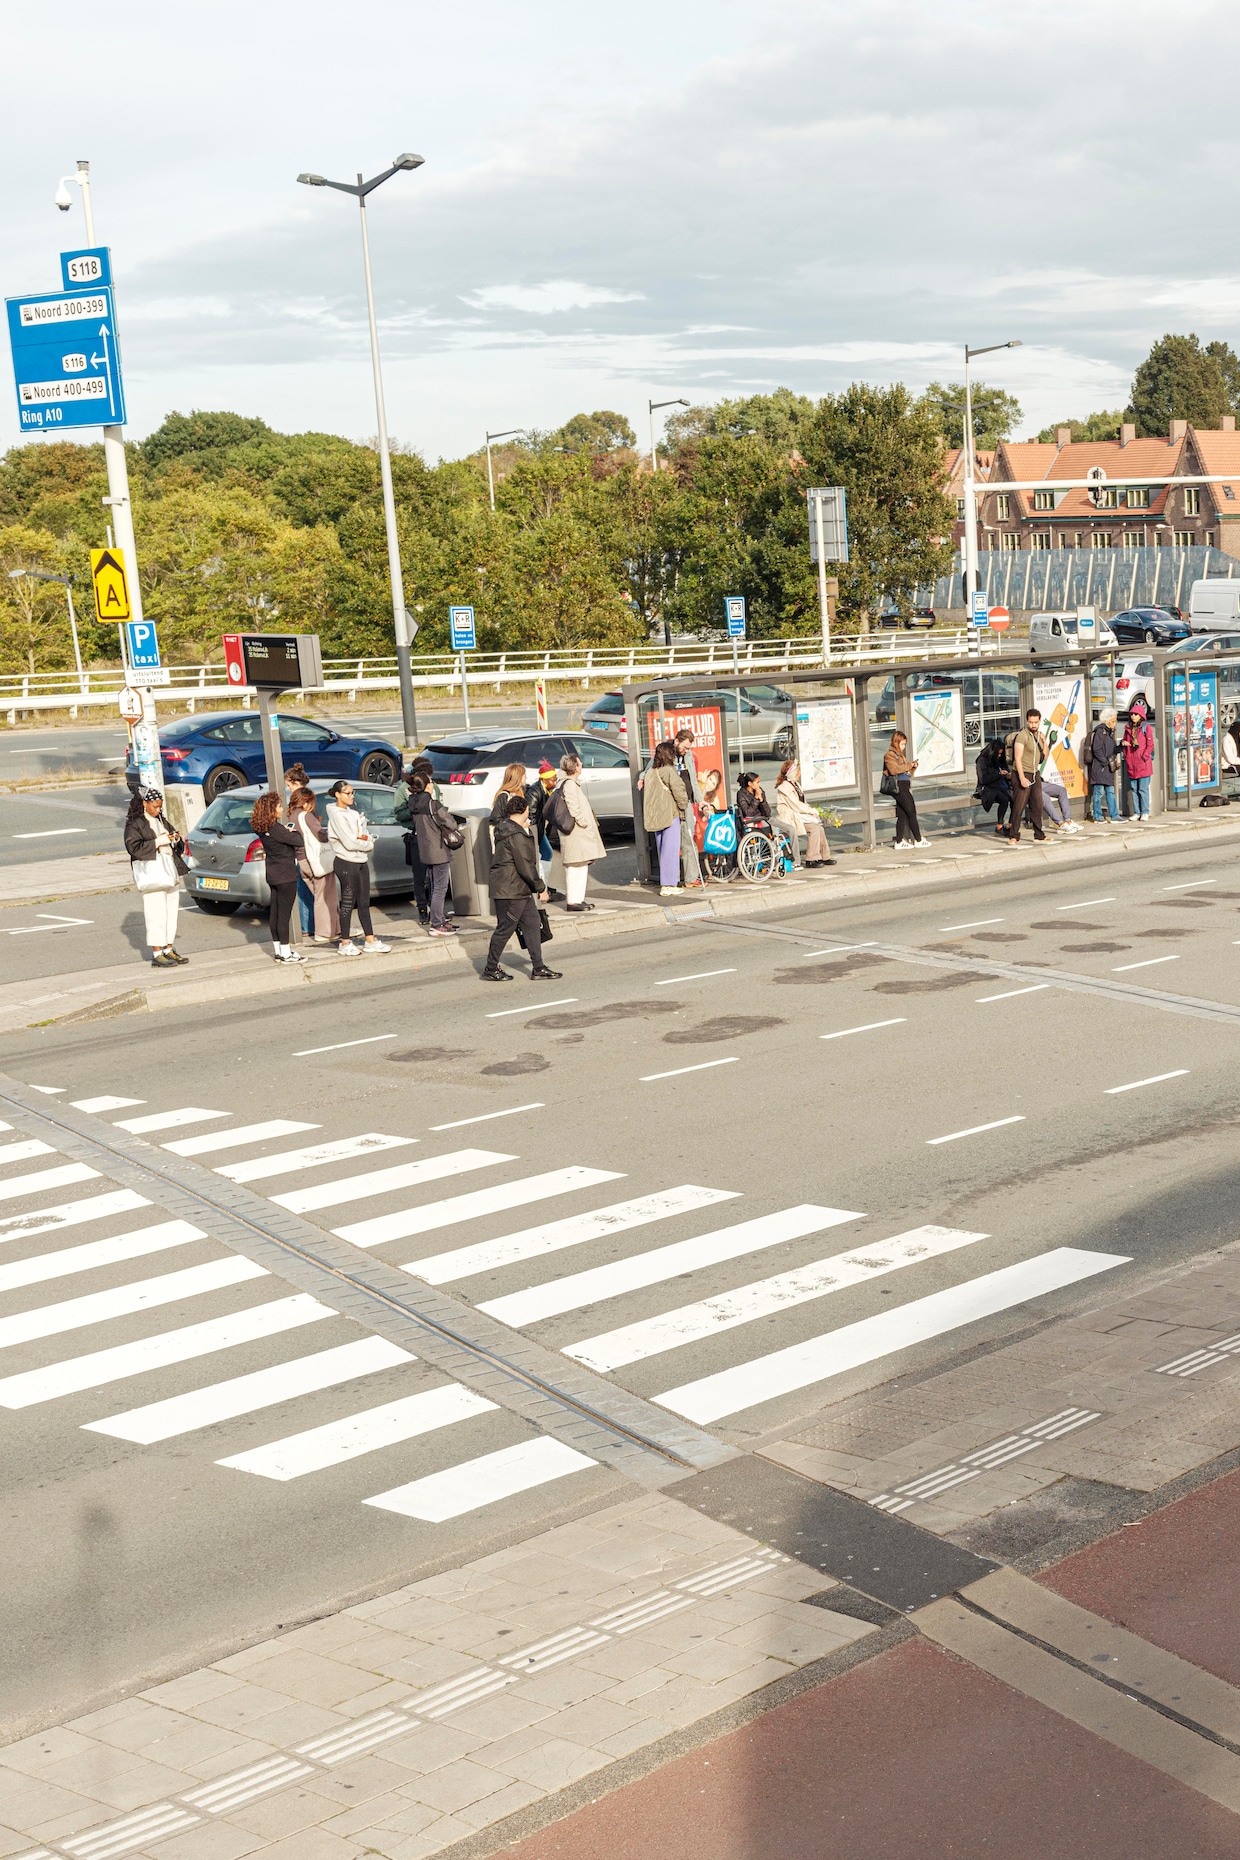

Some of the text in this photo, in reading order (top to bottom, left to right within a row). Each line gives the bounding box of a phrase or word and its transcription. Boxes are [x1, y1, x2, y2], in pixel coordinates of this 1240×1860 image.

[71, 260, 98, 277] S 118
[34, 299, 104, 319] Noord 300-399
[65, 356, 84, 368] S 116
[34, 380, 104, 398] Noord 400-499
[22, 408, 63, 426] Ring A10
[105, 584, 121, 607] A
[134, 625, 150, 649] P
[135, 653, 158, 664] taxi
[653, 714, 716, 740] HET GELUID
[698, 736, 707, 748] HET
[708, 736, 716, 746] IS?
